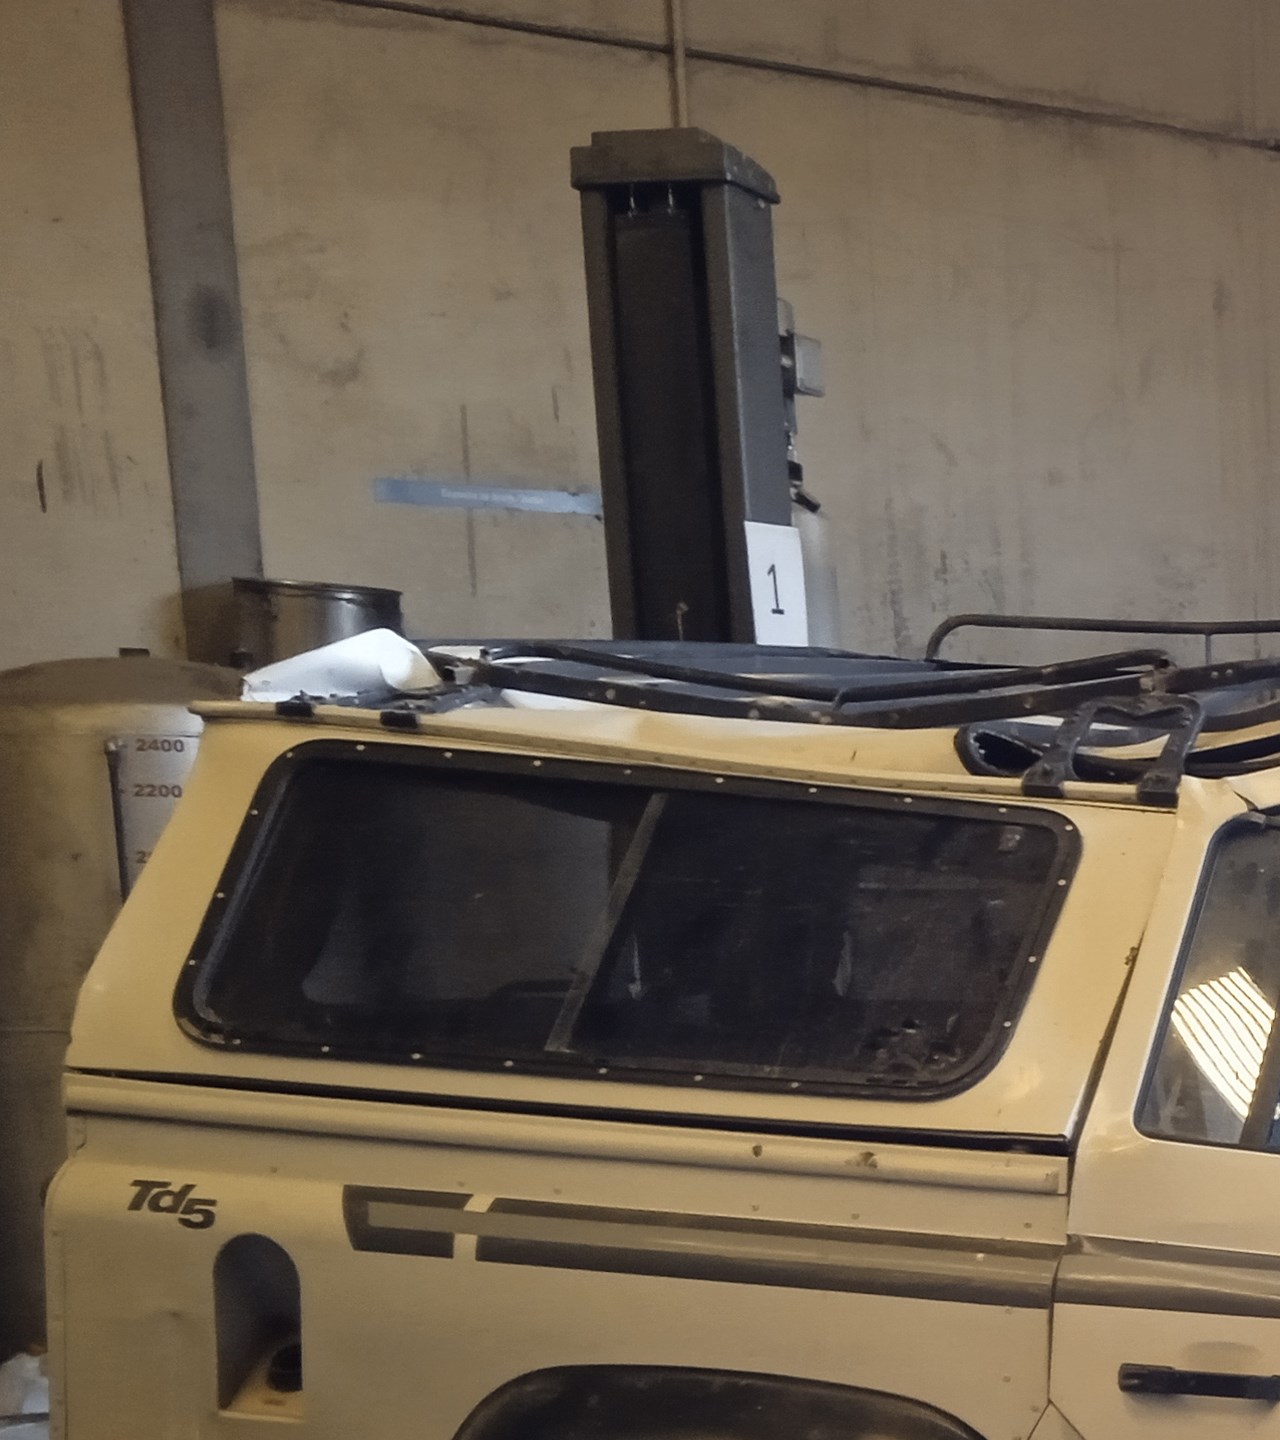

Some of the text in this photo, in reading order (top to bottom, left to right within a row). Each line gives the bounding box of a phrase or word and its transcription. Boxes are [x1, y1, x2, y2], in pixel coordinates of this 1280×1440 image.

[767, 563, 785, 615] 1
[136, 739, 185, 752] 2400
[134, 784, 183, 798] 2200
[127, 1179, 218, 1229] Td5
